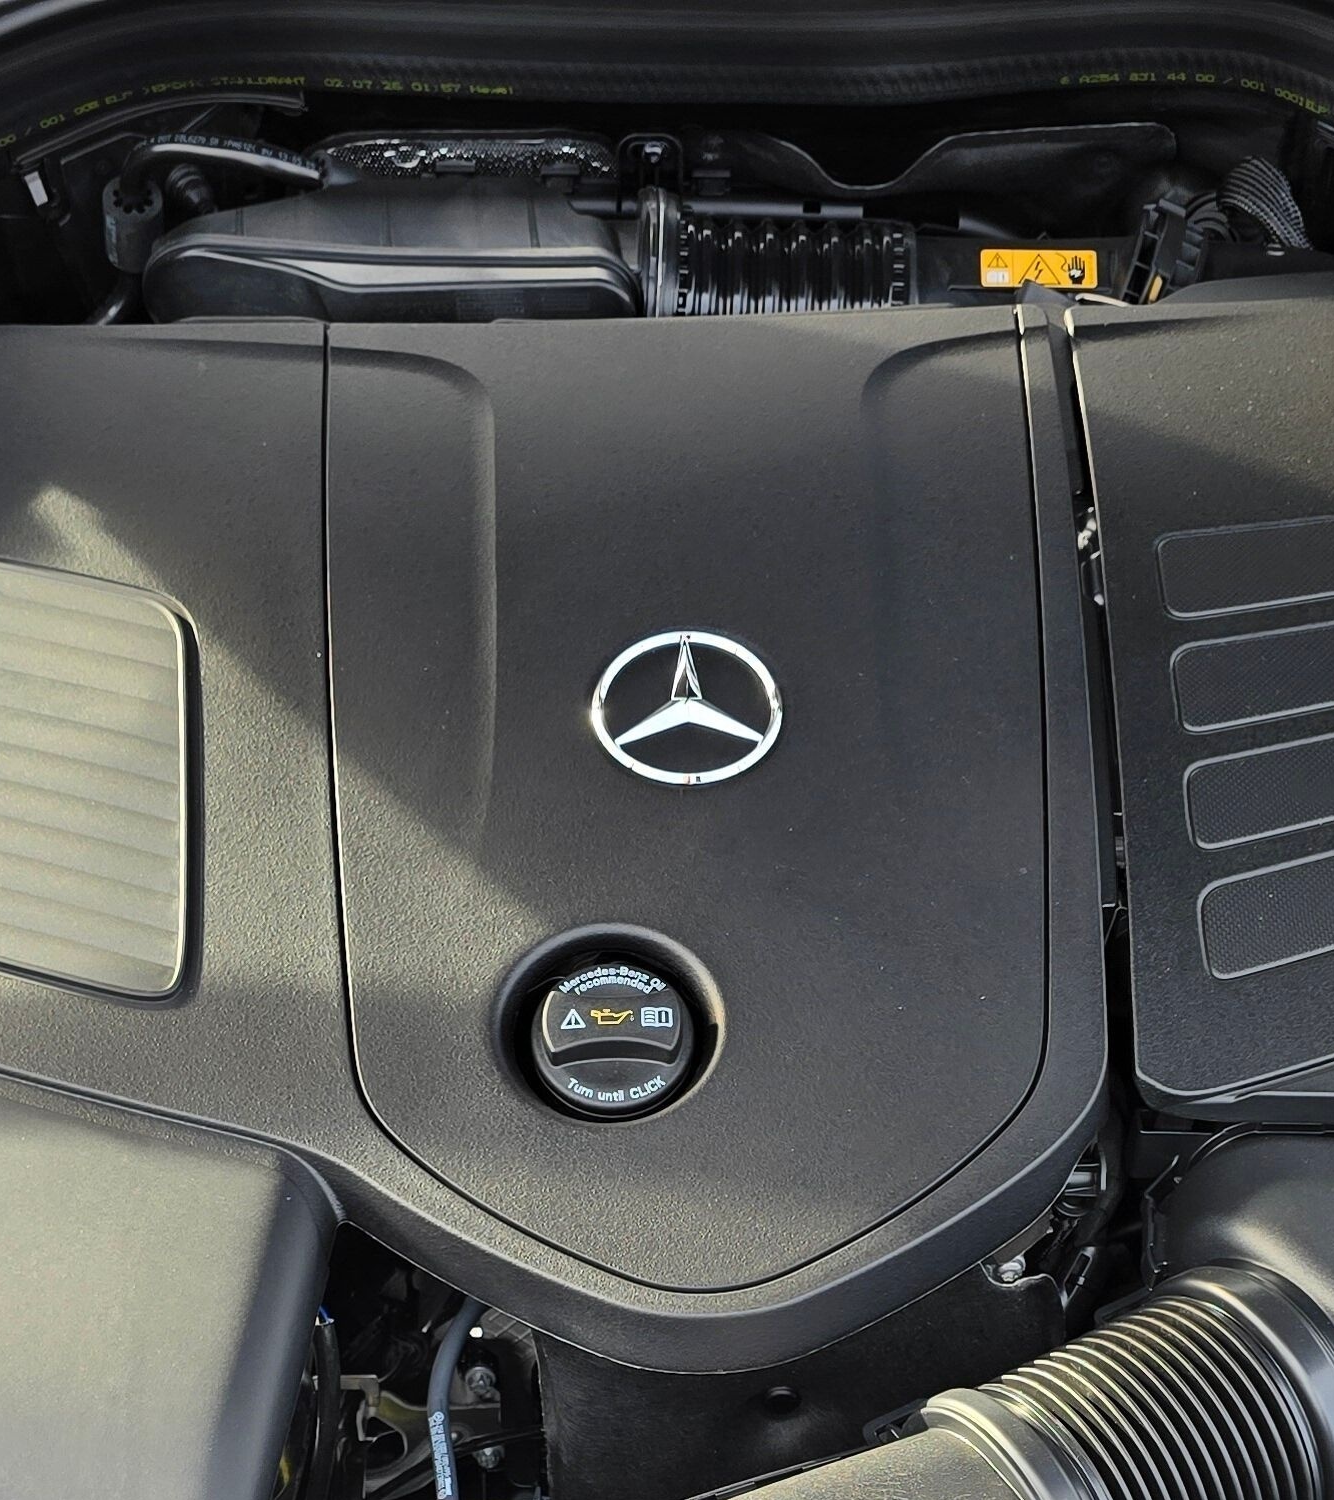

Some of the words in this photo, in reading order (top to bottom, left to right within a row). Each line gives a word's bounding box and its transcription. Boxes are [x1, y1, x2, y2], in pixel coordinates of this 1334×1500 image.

[1167, 71, 1187, 82] 44
[558, 965, 651, 995] Mercedes-Benz
[649, 976, 667, 992] Oil
[574, 975, 653, 996] recommended
[566, 1077, 594, 1099] Turn
[597, 1089, 625, 1102] until
[629, 1075, 667, 1100] CLICK
